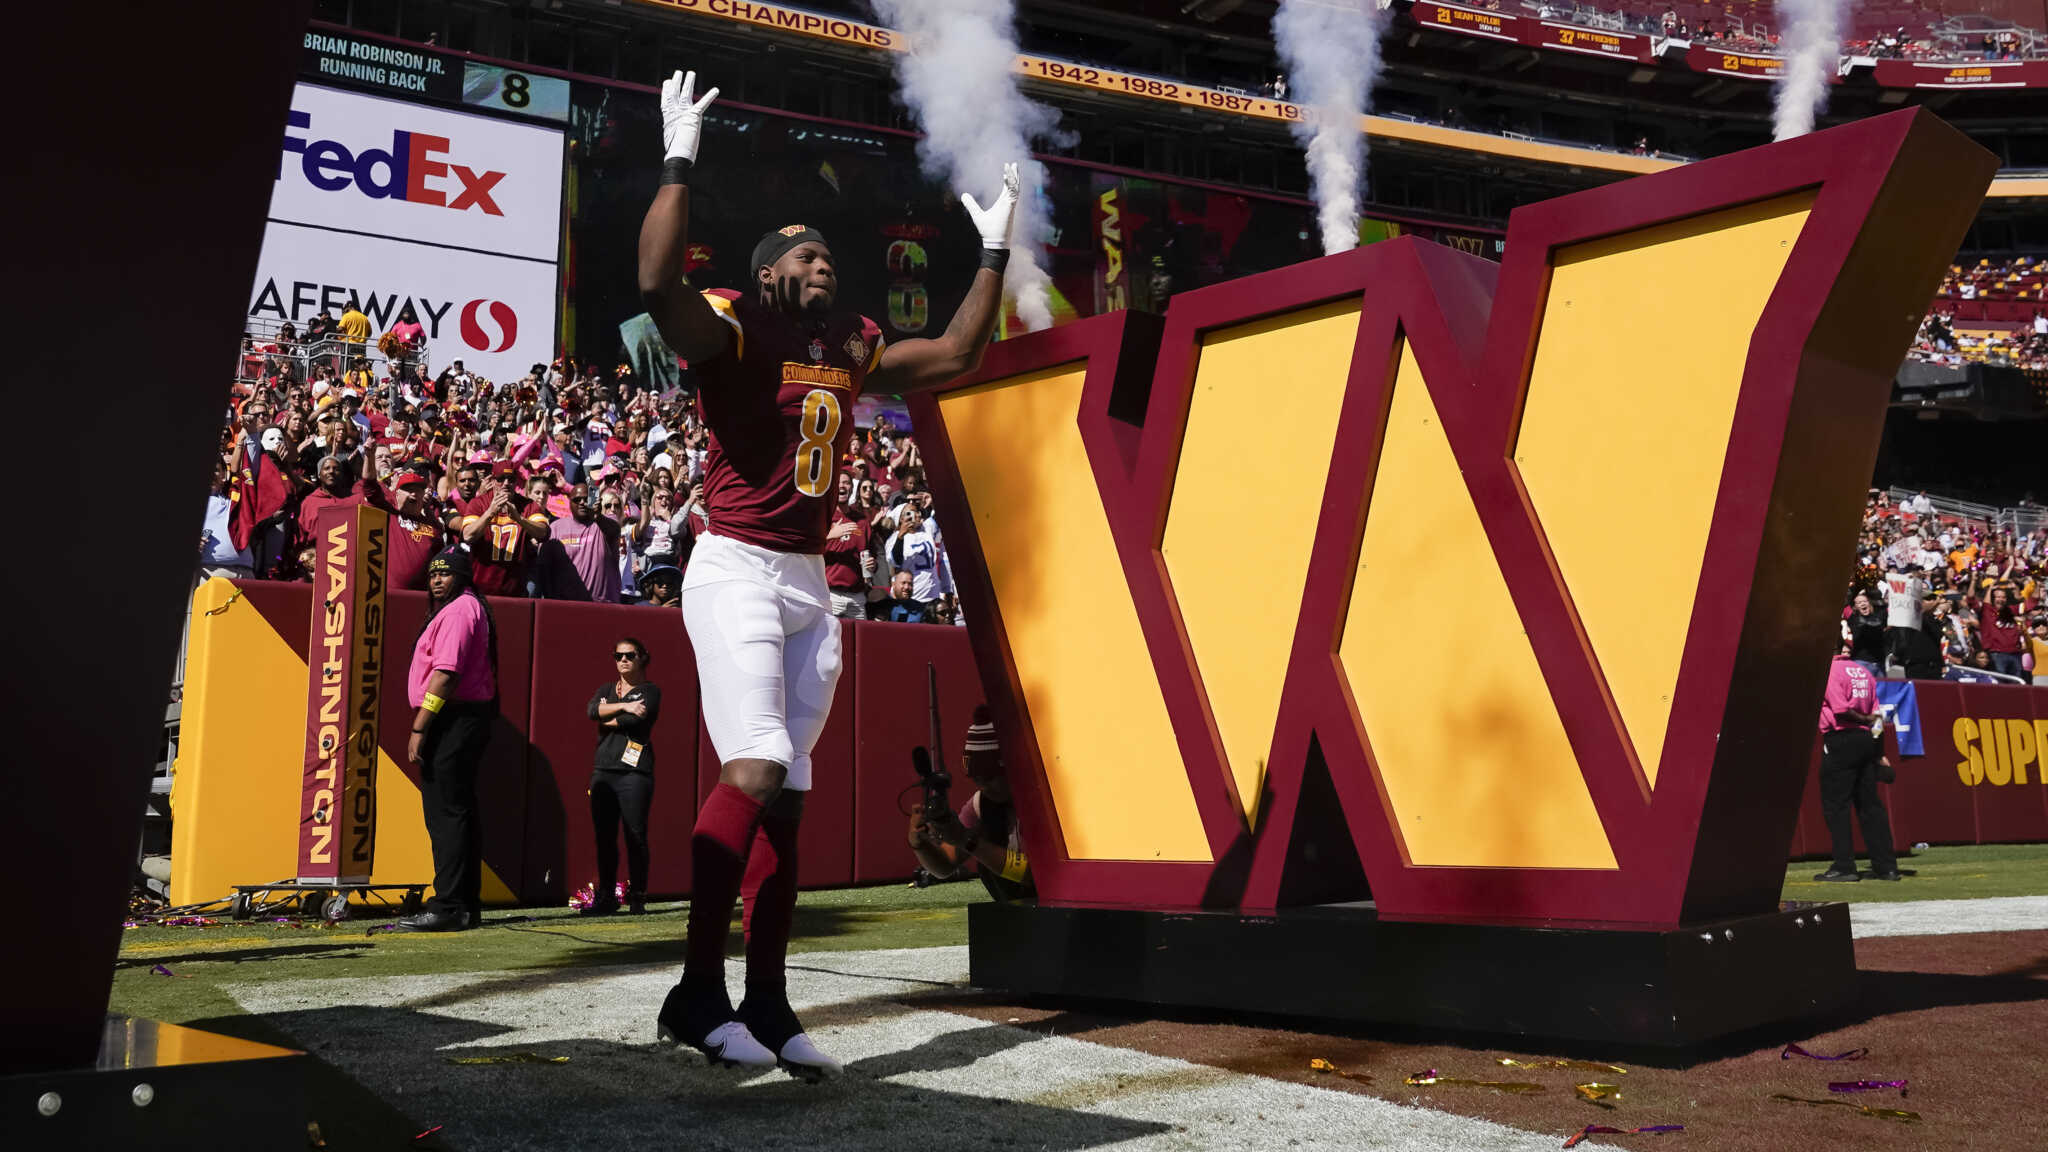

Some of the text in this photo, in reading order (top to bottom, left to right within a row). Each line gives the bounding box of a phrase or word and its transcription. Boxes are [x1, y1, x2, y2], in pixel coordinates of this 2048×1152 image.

[708, 0, 892, 46] CHAMPIONS
[303, 33, 446, 75] BRIAN ROBINSON JR.
[320, 57, 427, 92] RUNNING BACK
[501, 73, 531, 109] 8
[1038, 61, 1314, 123] 1942 1982 1987 199
[249, 276, 454, 339] AFEWAY
[783, 365, 852, 387] COMMANDERS
[794, 389, 842, 498] 8
[490, 523, 519, 562] 17
[310, 520, 348, 865] WASHINGTON
[352, 527, 384, 863] WASHINGTON
